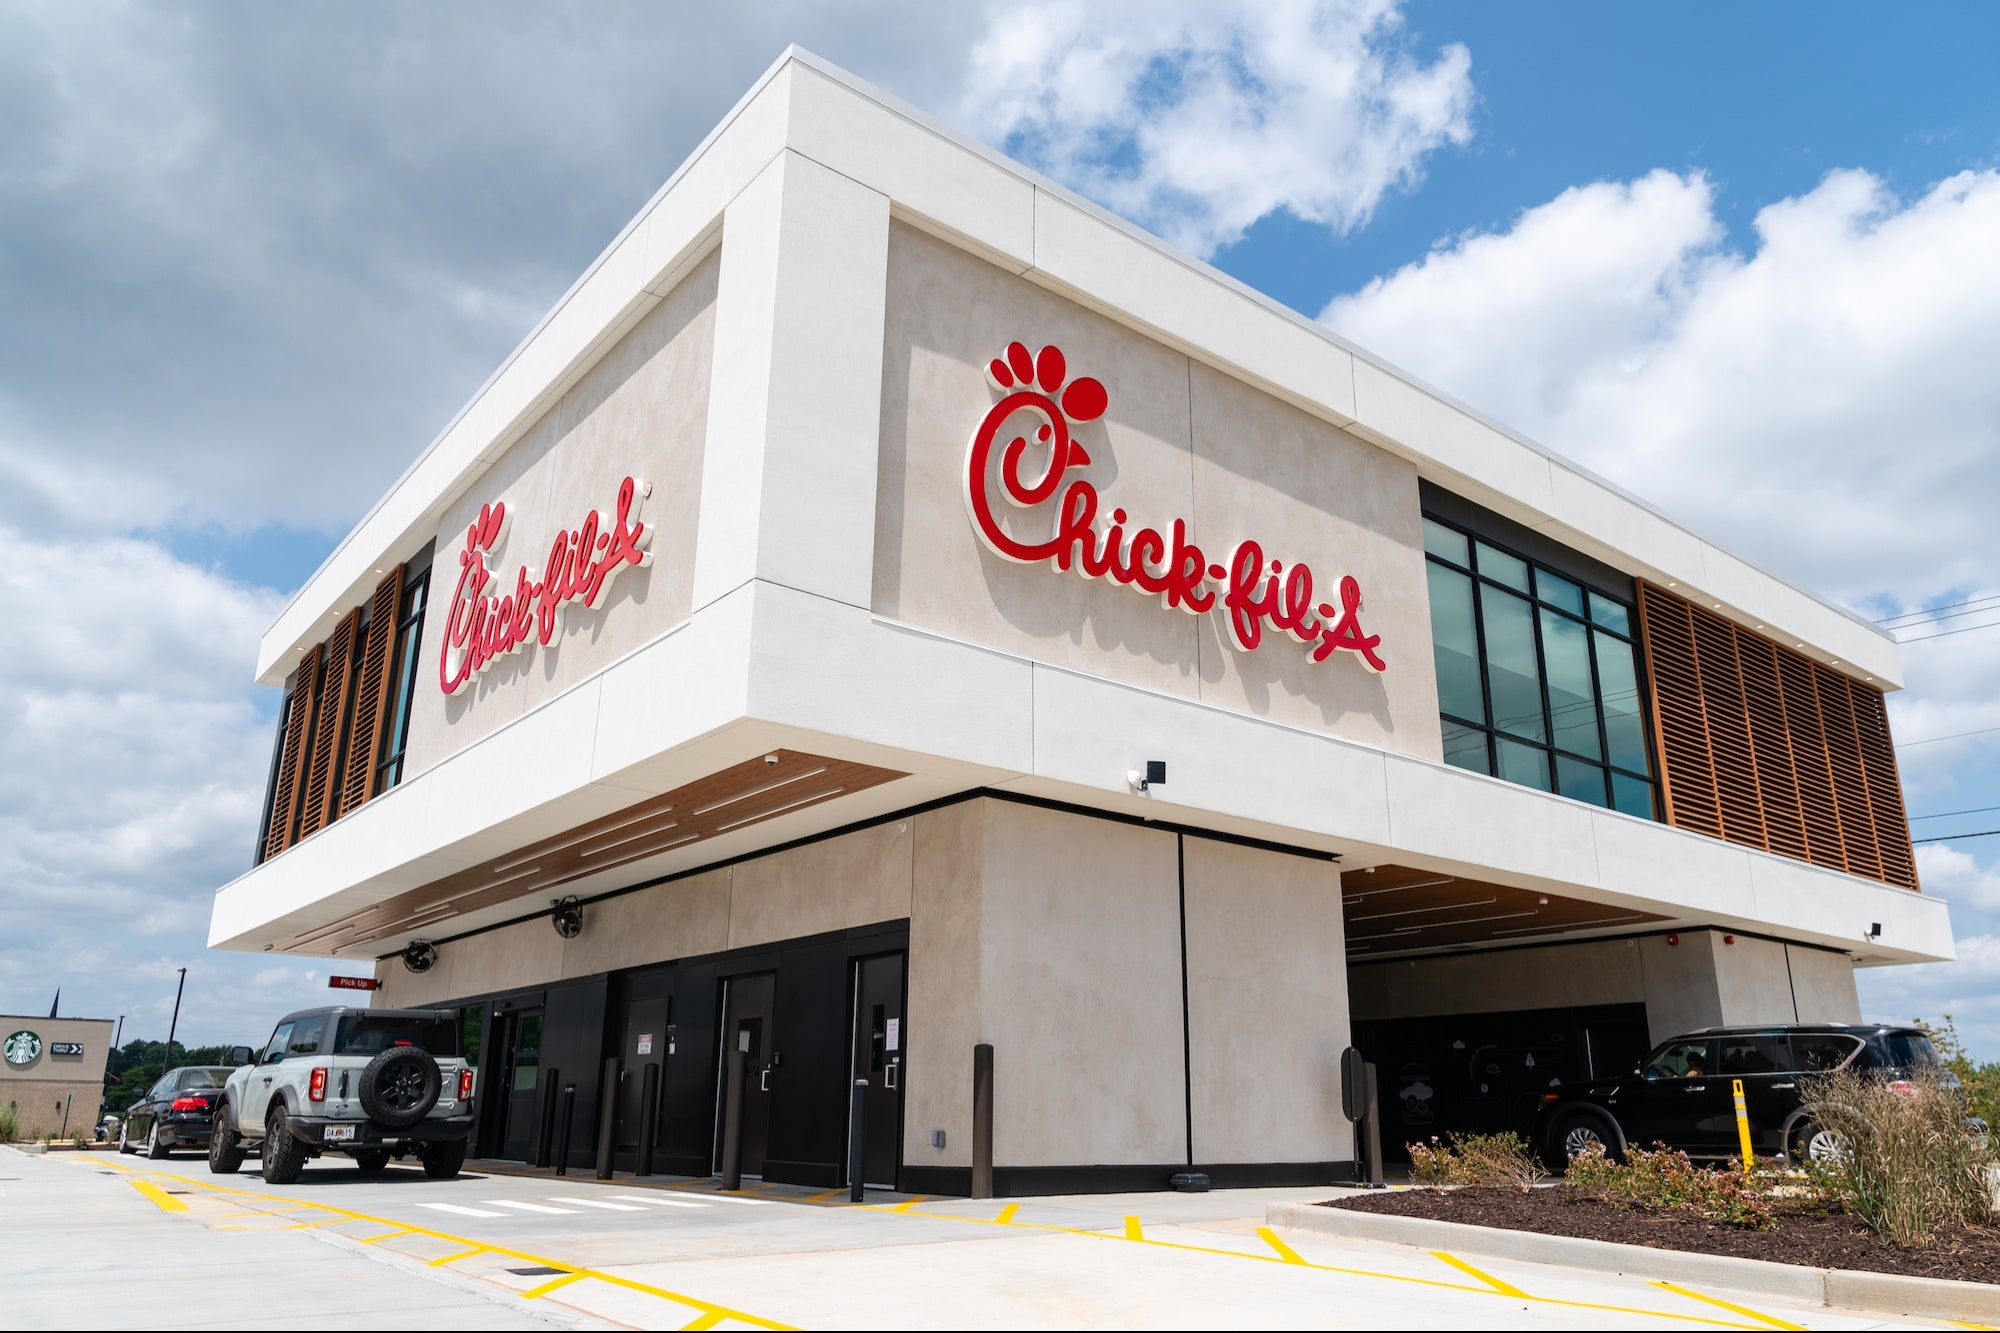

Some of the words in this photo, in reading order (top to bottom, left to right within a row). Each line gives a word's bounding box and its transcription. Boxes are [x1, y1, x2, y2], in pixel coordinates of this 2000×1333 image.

[440, 476, 648, 695] Chick-fil-A
[965, 342, 1386, 671] Chick-fil-A
[340, 978, 356, 986] Pick
[357, 980, 368, 988] Up
